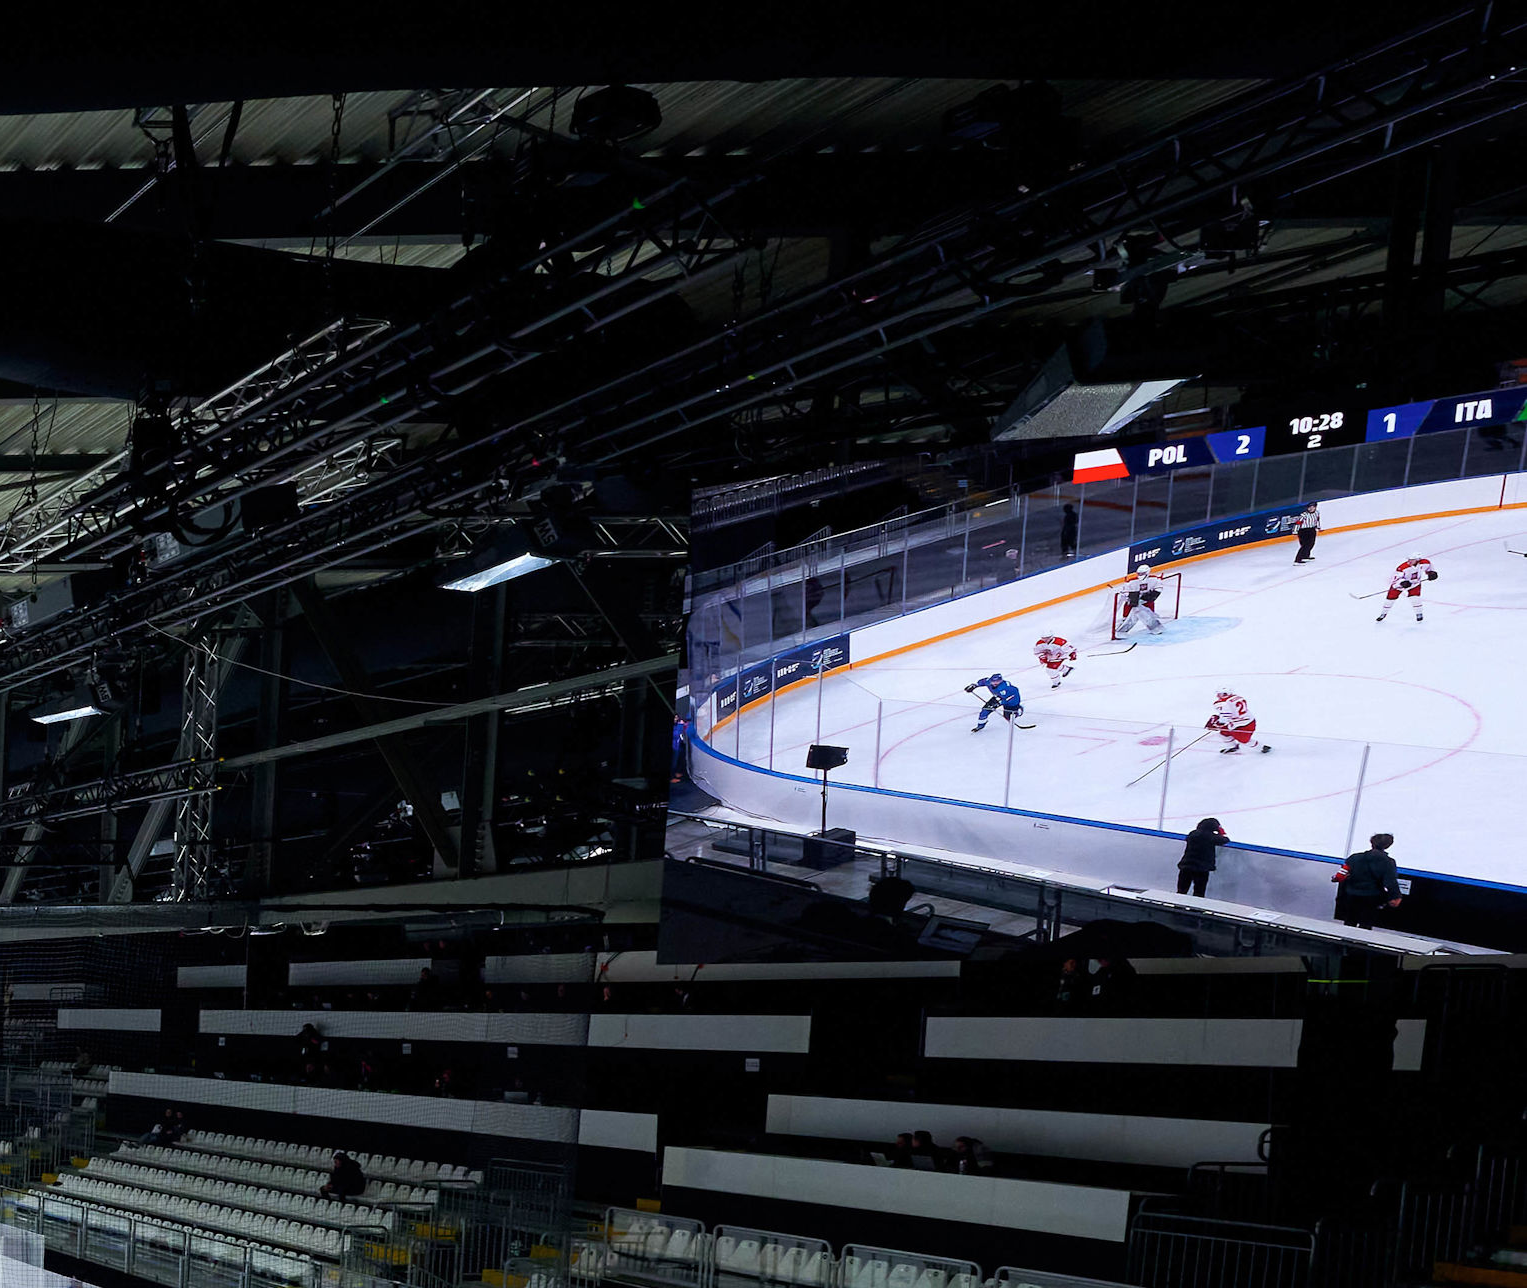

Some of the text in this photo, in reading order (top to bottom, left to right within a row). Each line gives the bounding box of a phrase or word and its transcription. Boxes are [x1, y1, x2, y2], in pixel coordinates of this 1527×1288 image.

[1147, 399, 1492, 467] POL 2 10:28 1 ITA
[1307, 435, 1322, 449] 2
